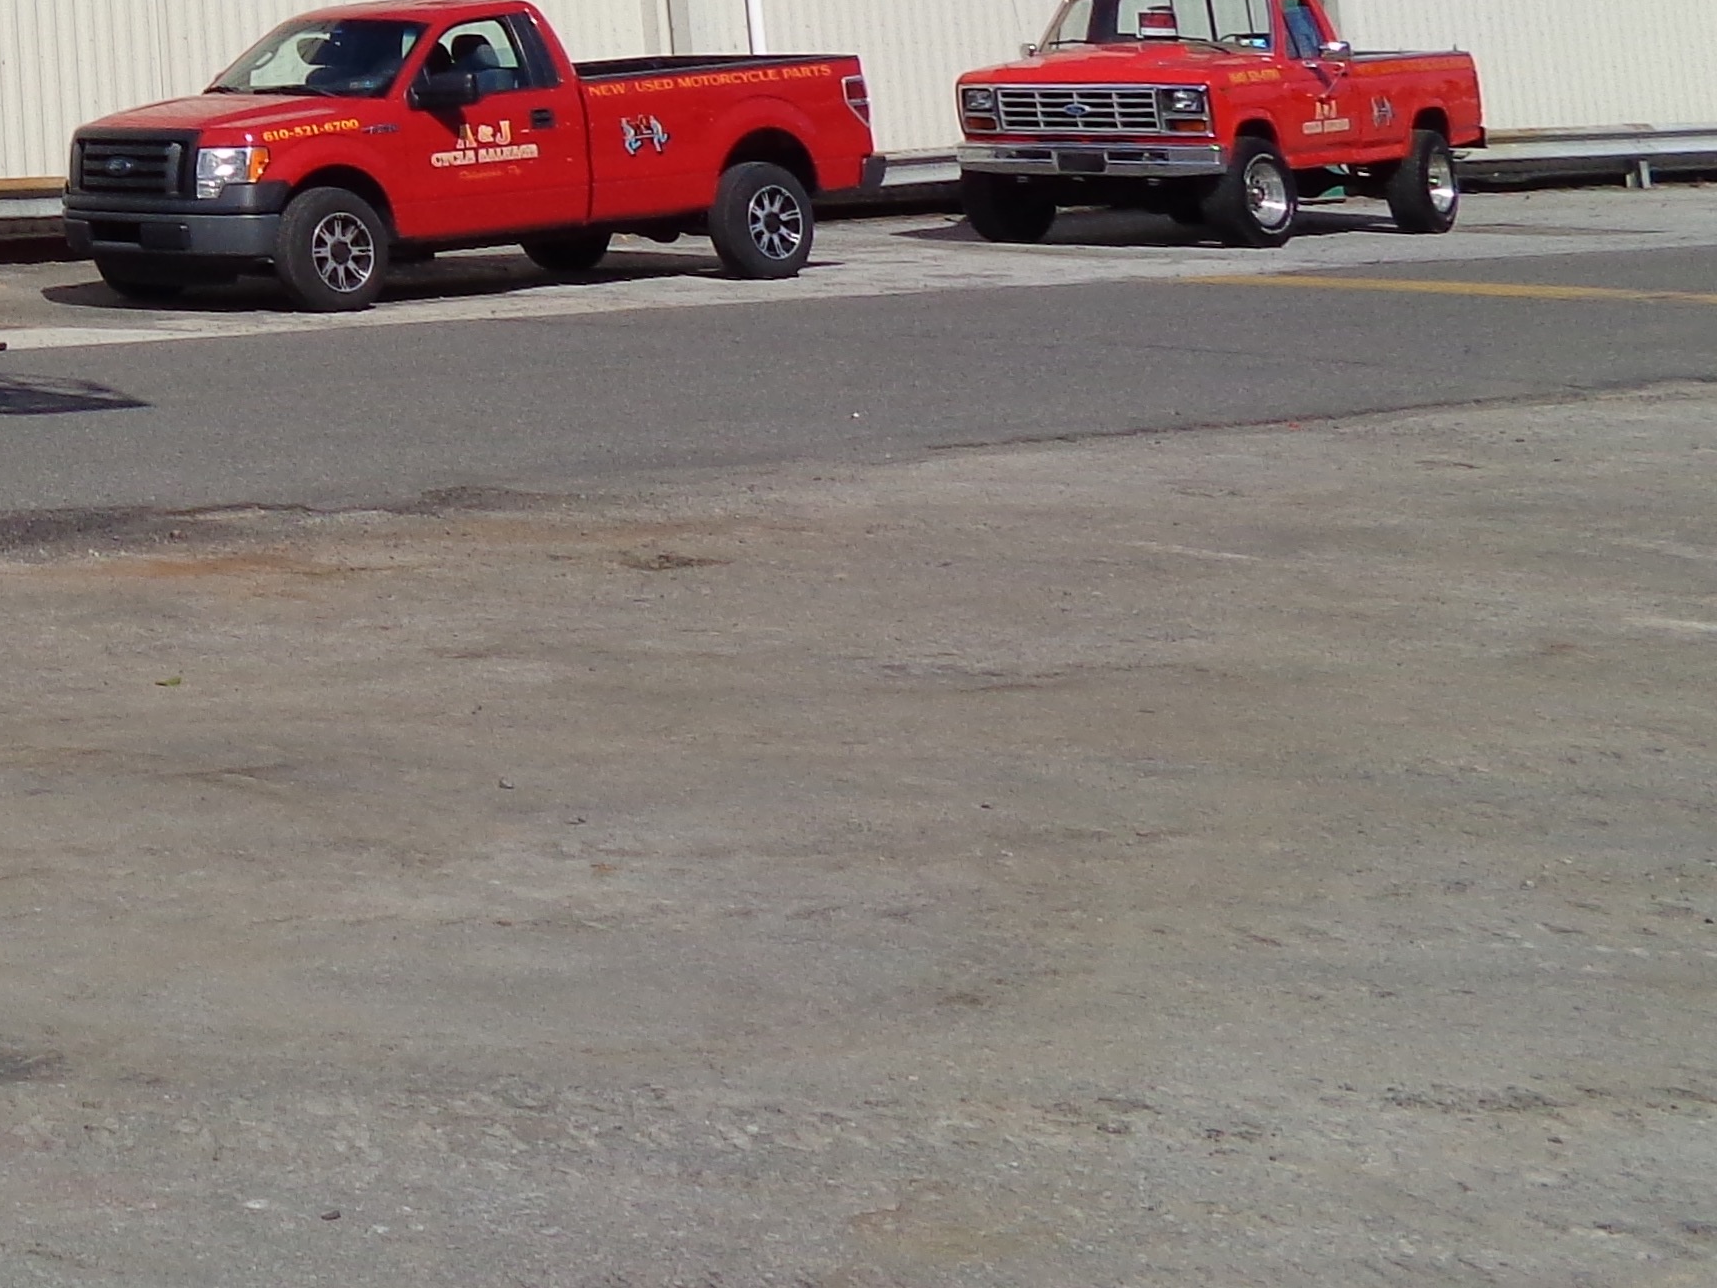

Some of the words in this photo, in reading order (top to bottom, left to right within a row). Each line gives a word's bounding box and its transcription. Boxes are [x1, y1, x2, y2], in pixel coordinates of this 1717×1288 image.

[588, 82, 626, 97] NEW
[635, 79, 674, 92] USED
[678, 69, 779, 88] MOTORCYCLE
[783, 64, 832, 80] PARTS
[263, 118, 359, 142] 610-521-6700
